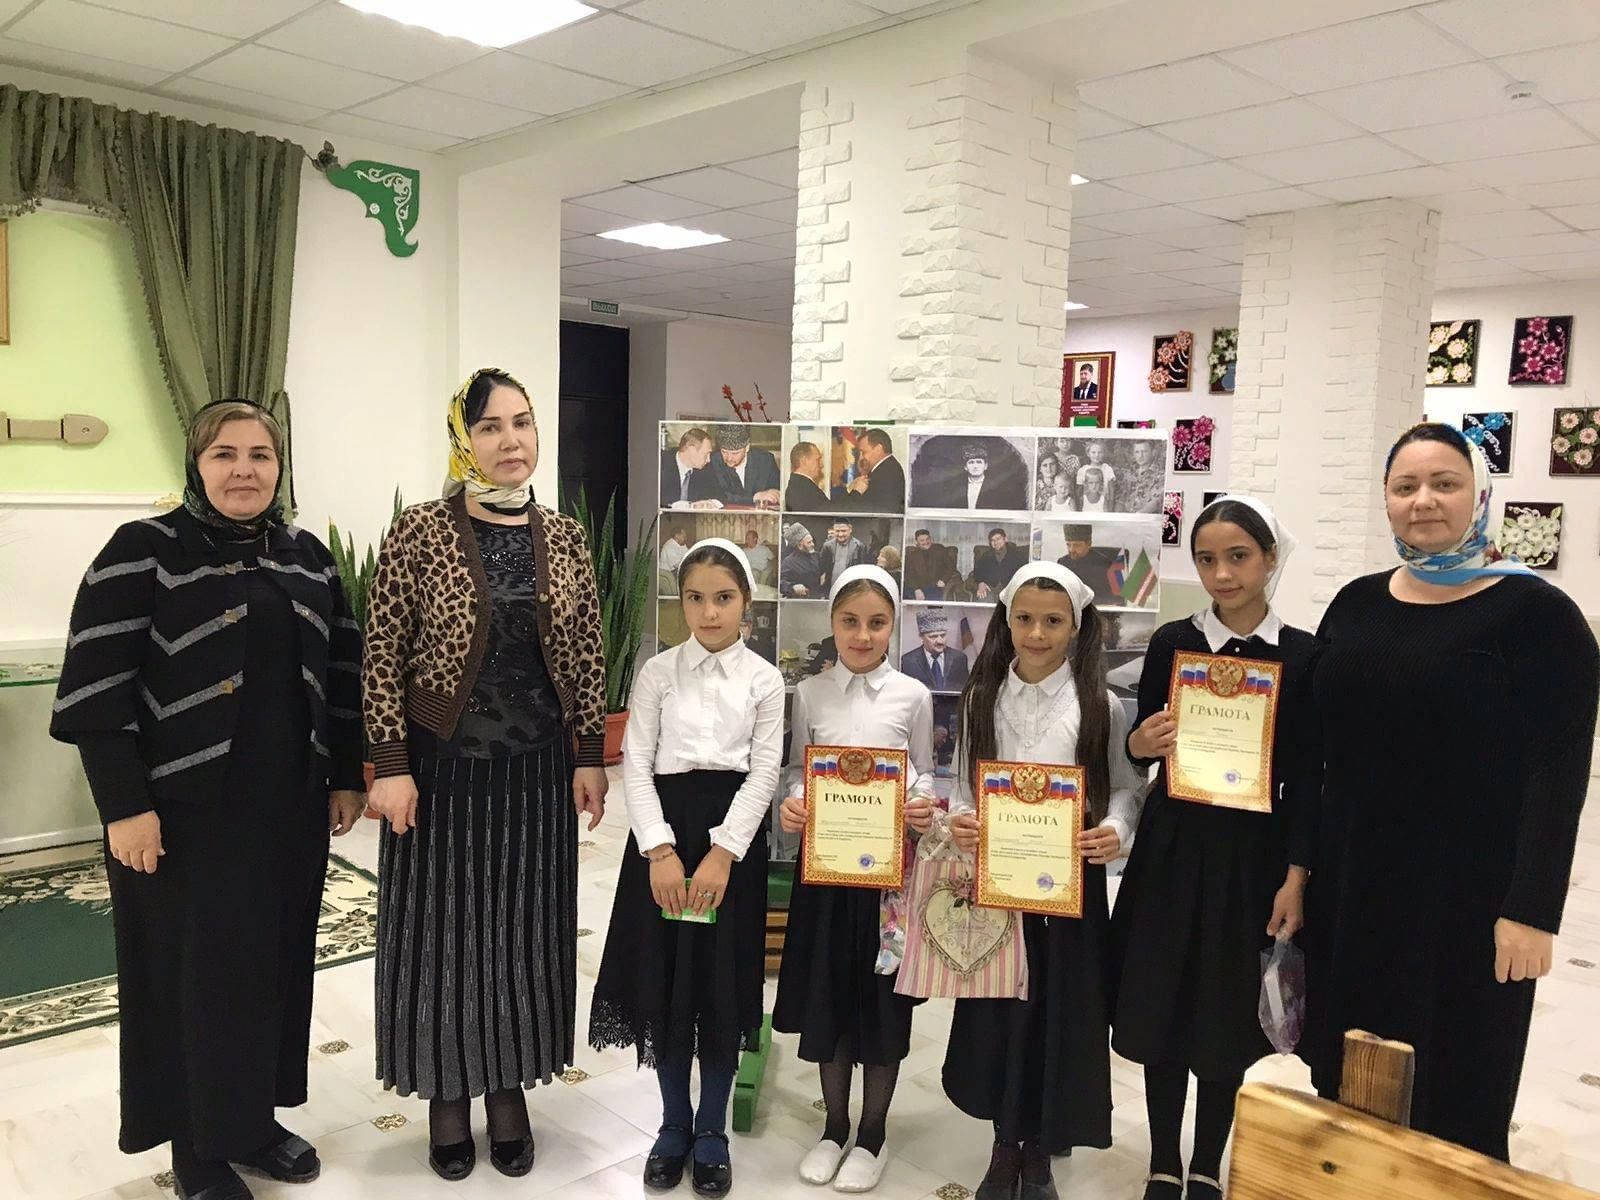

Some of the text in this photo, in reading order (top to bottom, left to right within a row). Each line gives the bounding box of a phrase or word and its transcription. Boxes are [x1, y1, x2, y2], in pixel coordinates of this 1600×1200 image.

[1190, 704, 1250, 721] ГРАМОТА
[825, 792, 882, 805] ГРАМОТА
[998, 812, 1058, 826] ГРАМОТА
